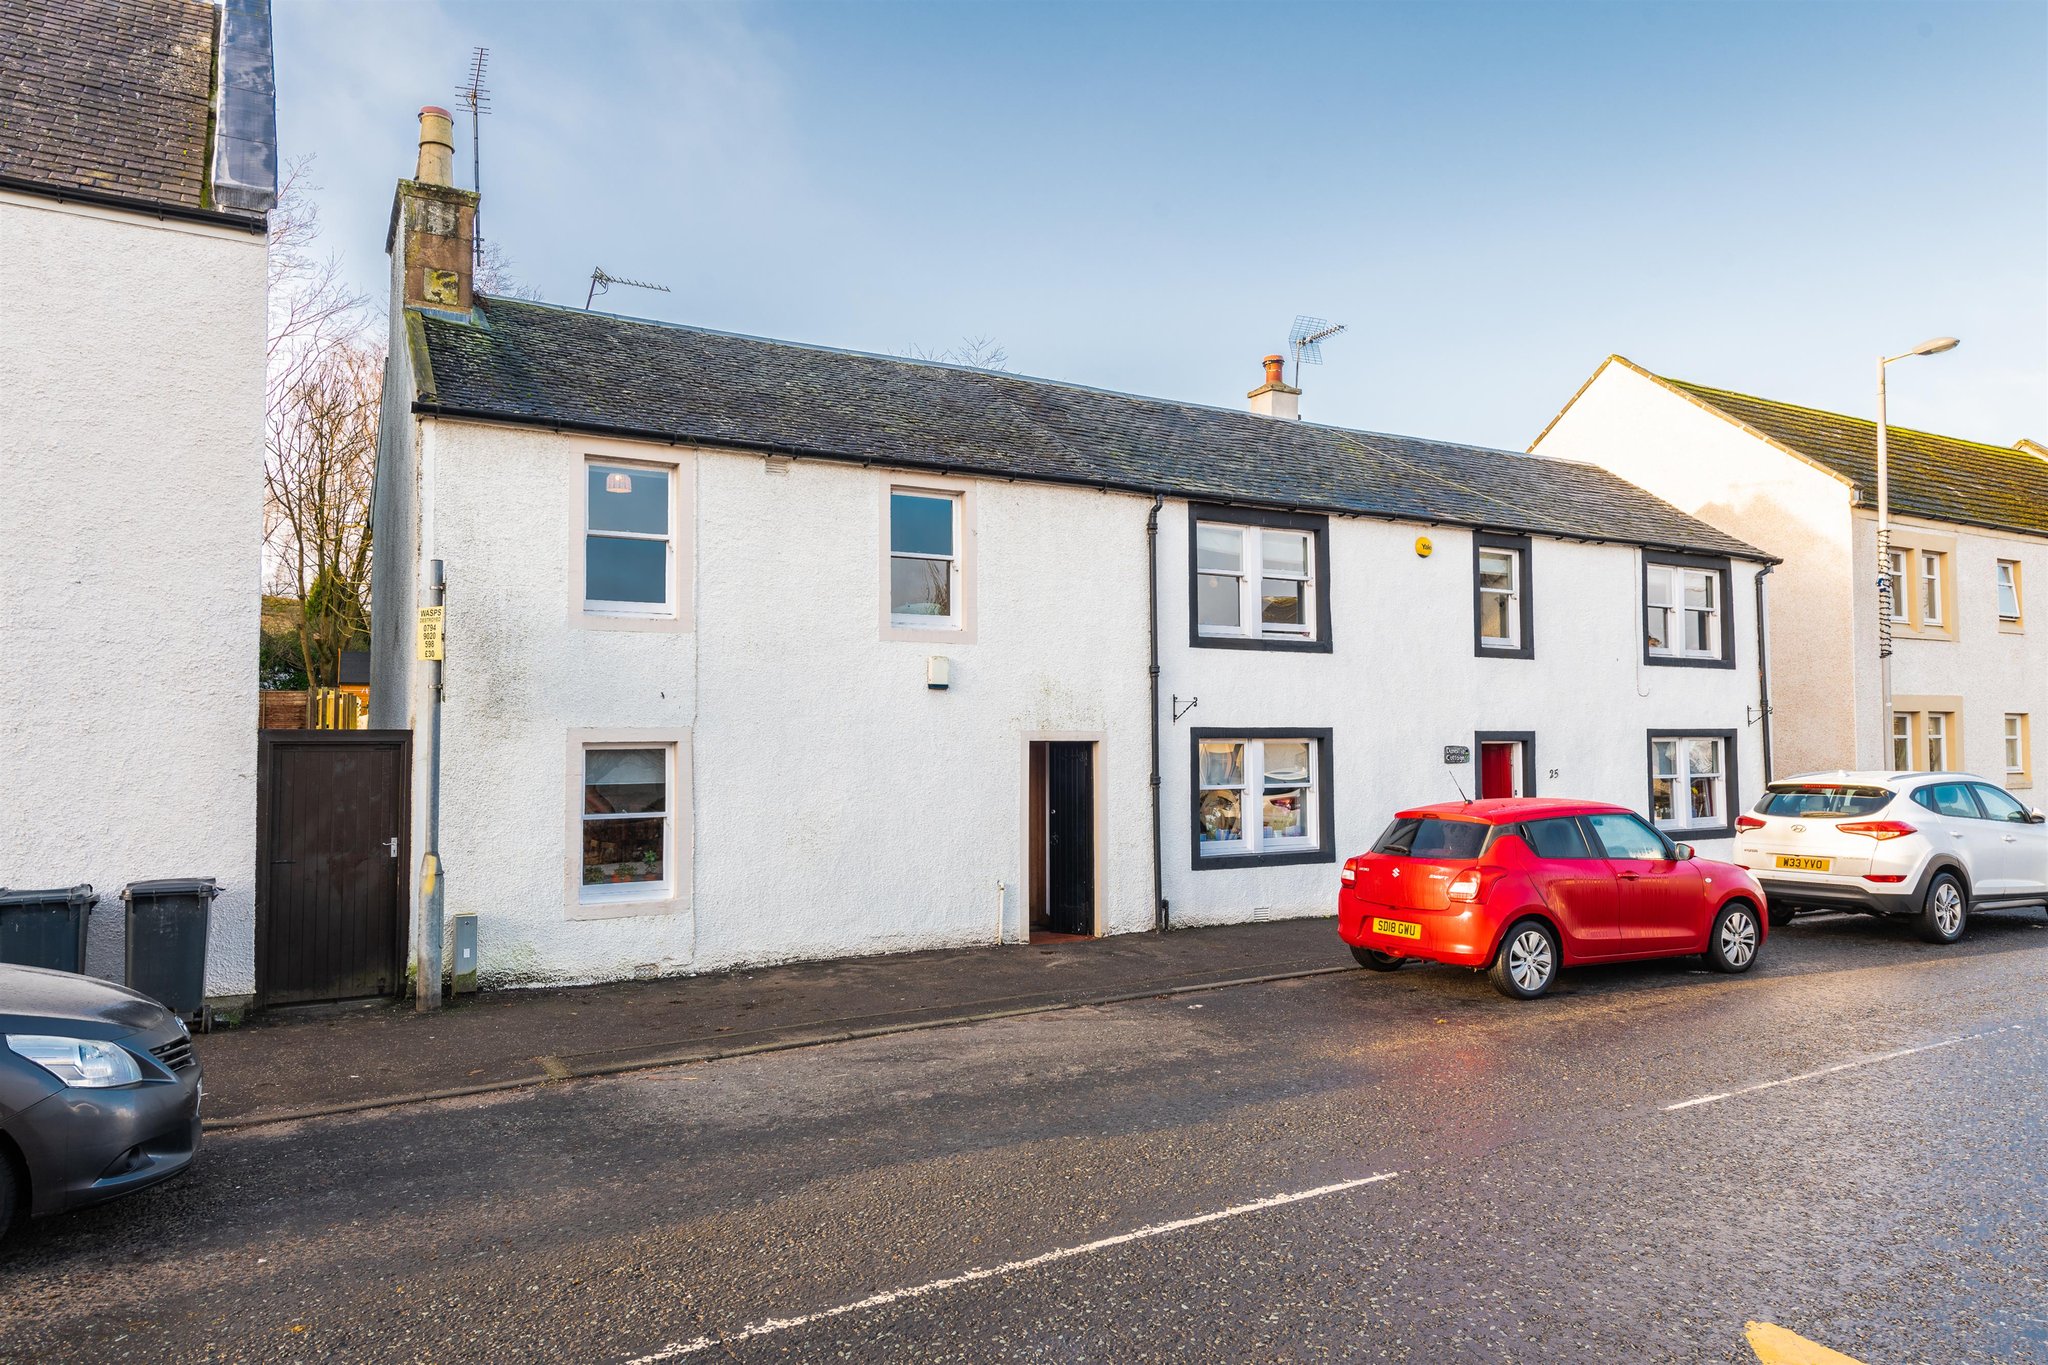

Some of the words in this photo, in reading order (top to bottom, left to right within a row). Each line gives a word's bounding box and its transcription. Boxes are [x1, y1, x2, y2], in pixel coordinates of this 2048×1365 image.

[420, 608, 442, 617] WASPS
[423, 632, 436, 640] 9020
[424, 640, 435, 648] 598
[1549, 768, 1559, 779] 25
[1783, 857, 1801, 868] W33
[1804, 859, 1823, 869] YVO
[1378, 920, 1396, 933] SD18
[1398, 923, 1416, 936] GWU
